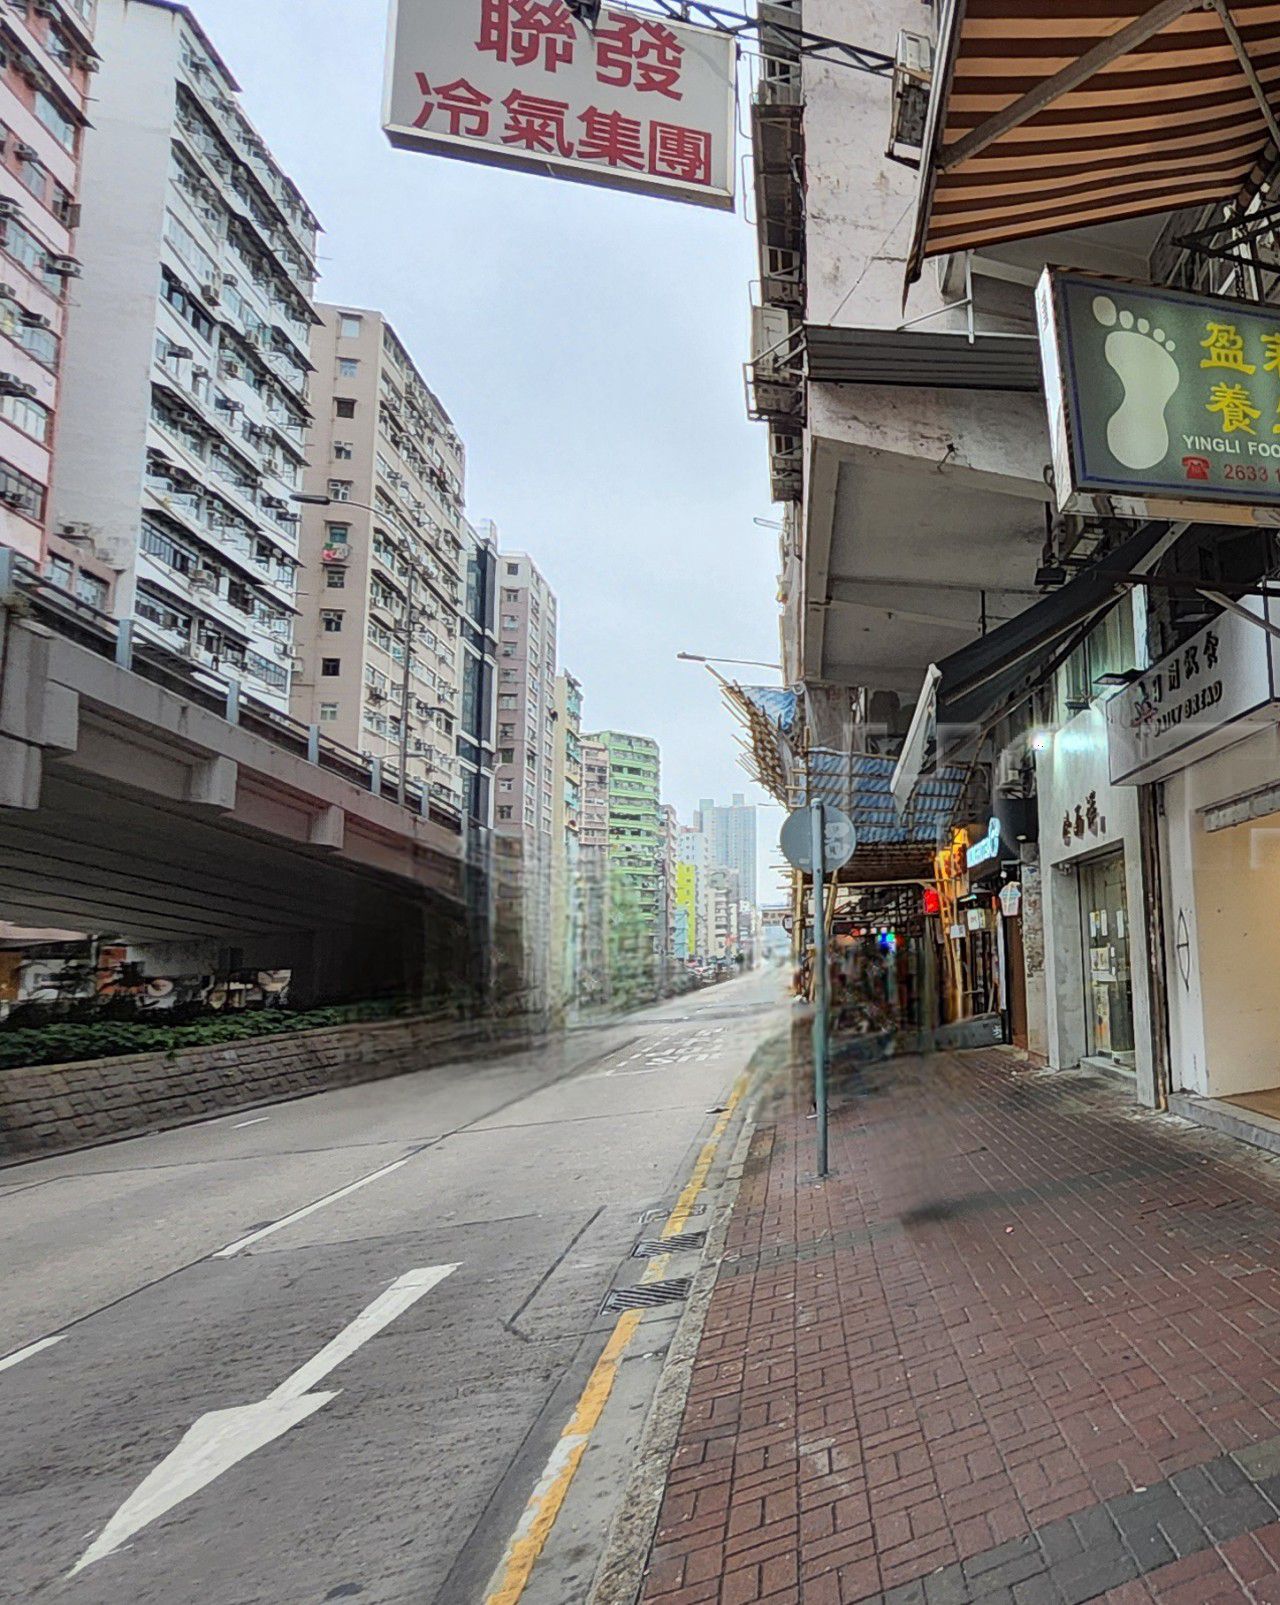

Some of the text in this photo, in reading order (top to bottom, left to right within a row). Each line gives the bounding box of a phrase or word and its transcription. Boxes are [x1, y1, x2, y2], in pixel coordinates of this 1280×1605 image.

[474, 0, 685, 101] 聯發
[412, 71, 713, 186] 冷氣集團
[1182, 434, 1241, 455] YINGLI
[1223, 463, 1269, 482] 2633
